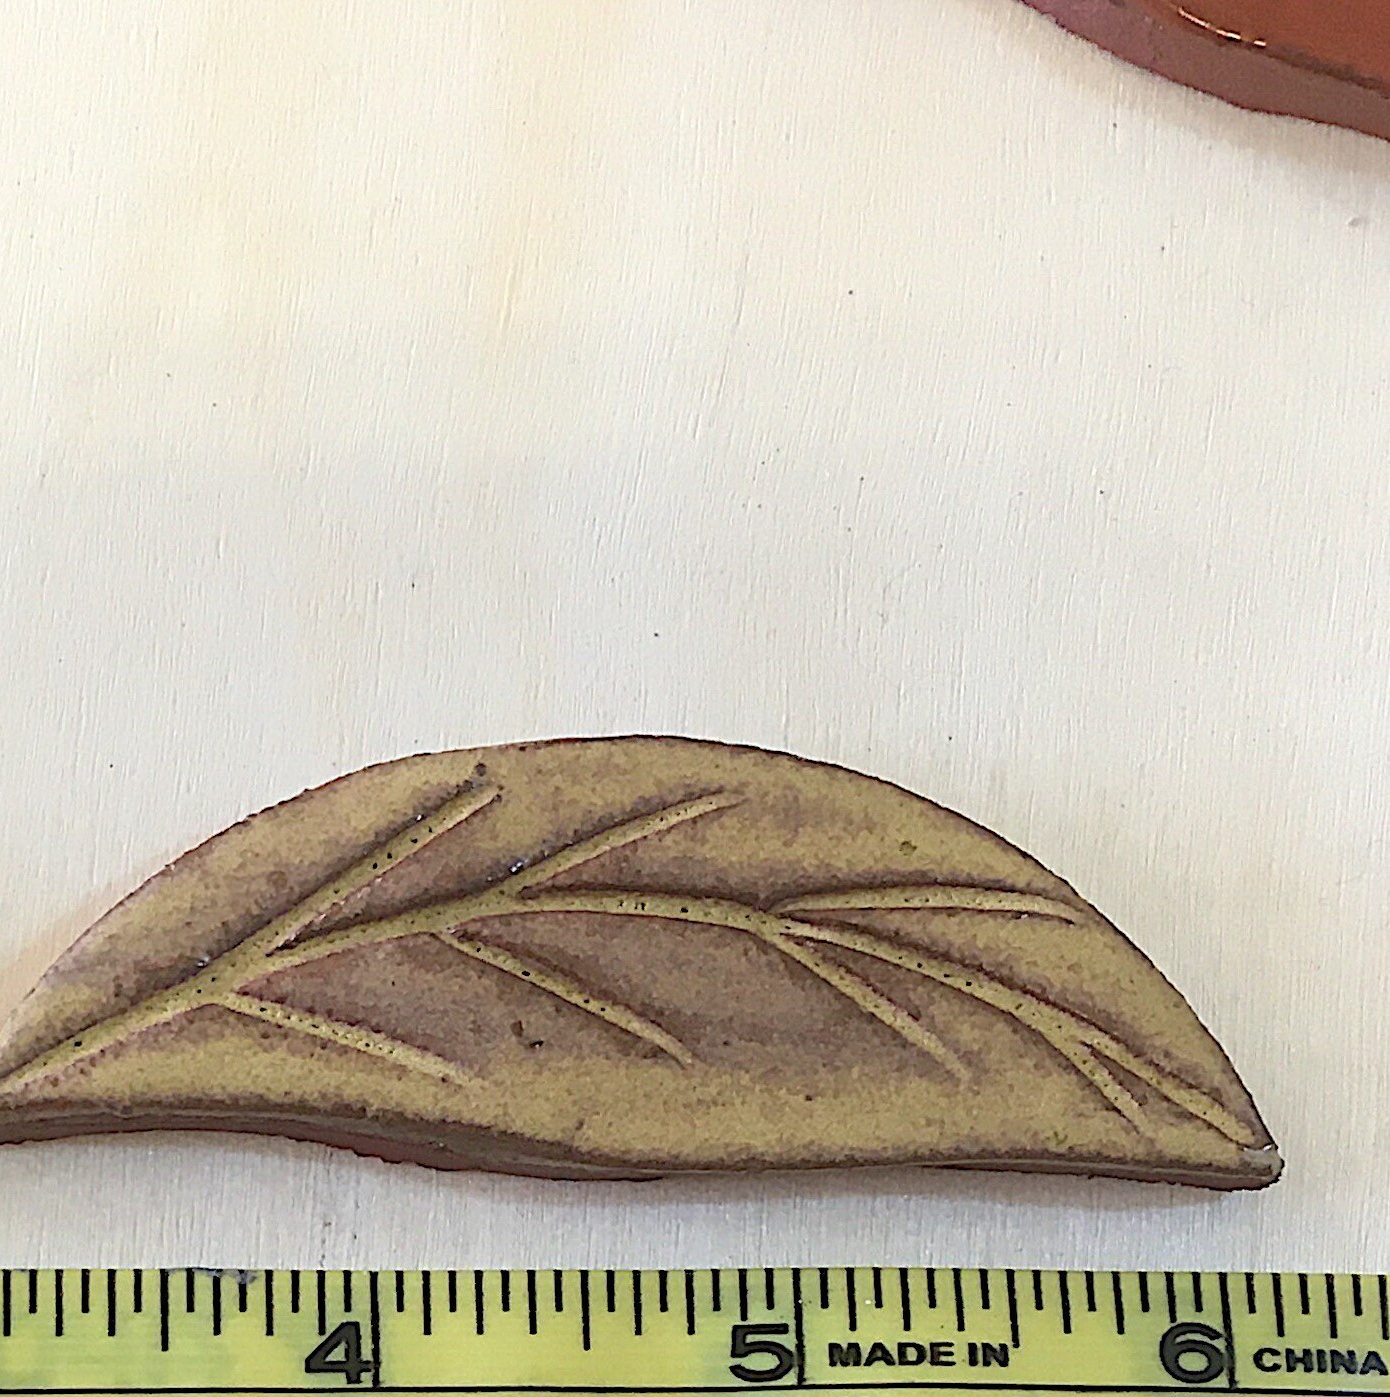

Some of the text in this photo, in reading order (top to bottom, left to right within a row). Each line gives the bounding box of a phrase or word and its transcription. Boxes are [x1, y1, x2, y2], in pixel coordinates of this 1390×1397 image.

[304, 1321, 375, 1385] 4
[729, 1323, 795, 1382] 5
[828, 1341, 1389, 1376] MADE IN CHINA
[1159, 1322, 1226, 1383] 6
